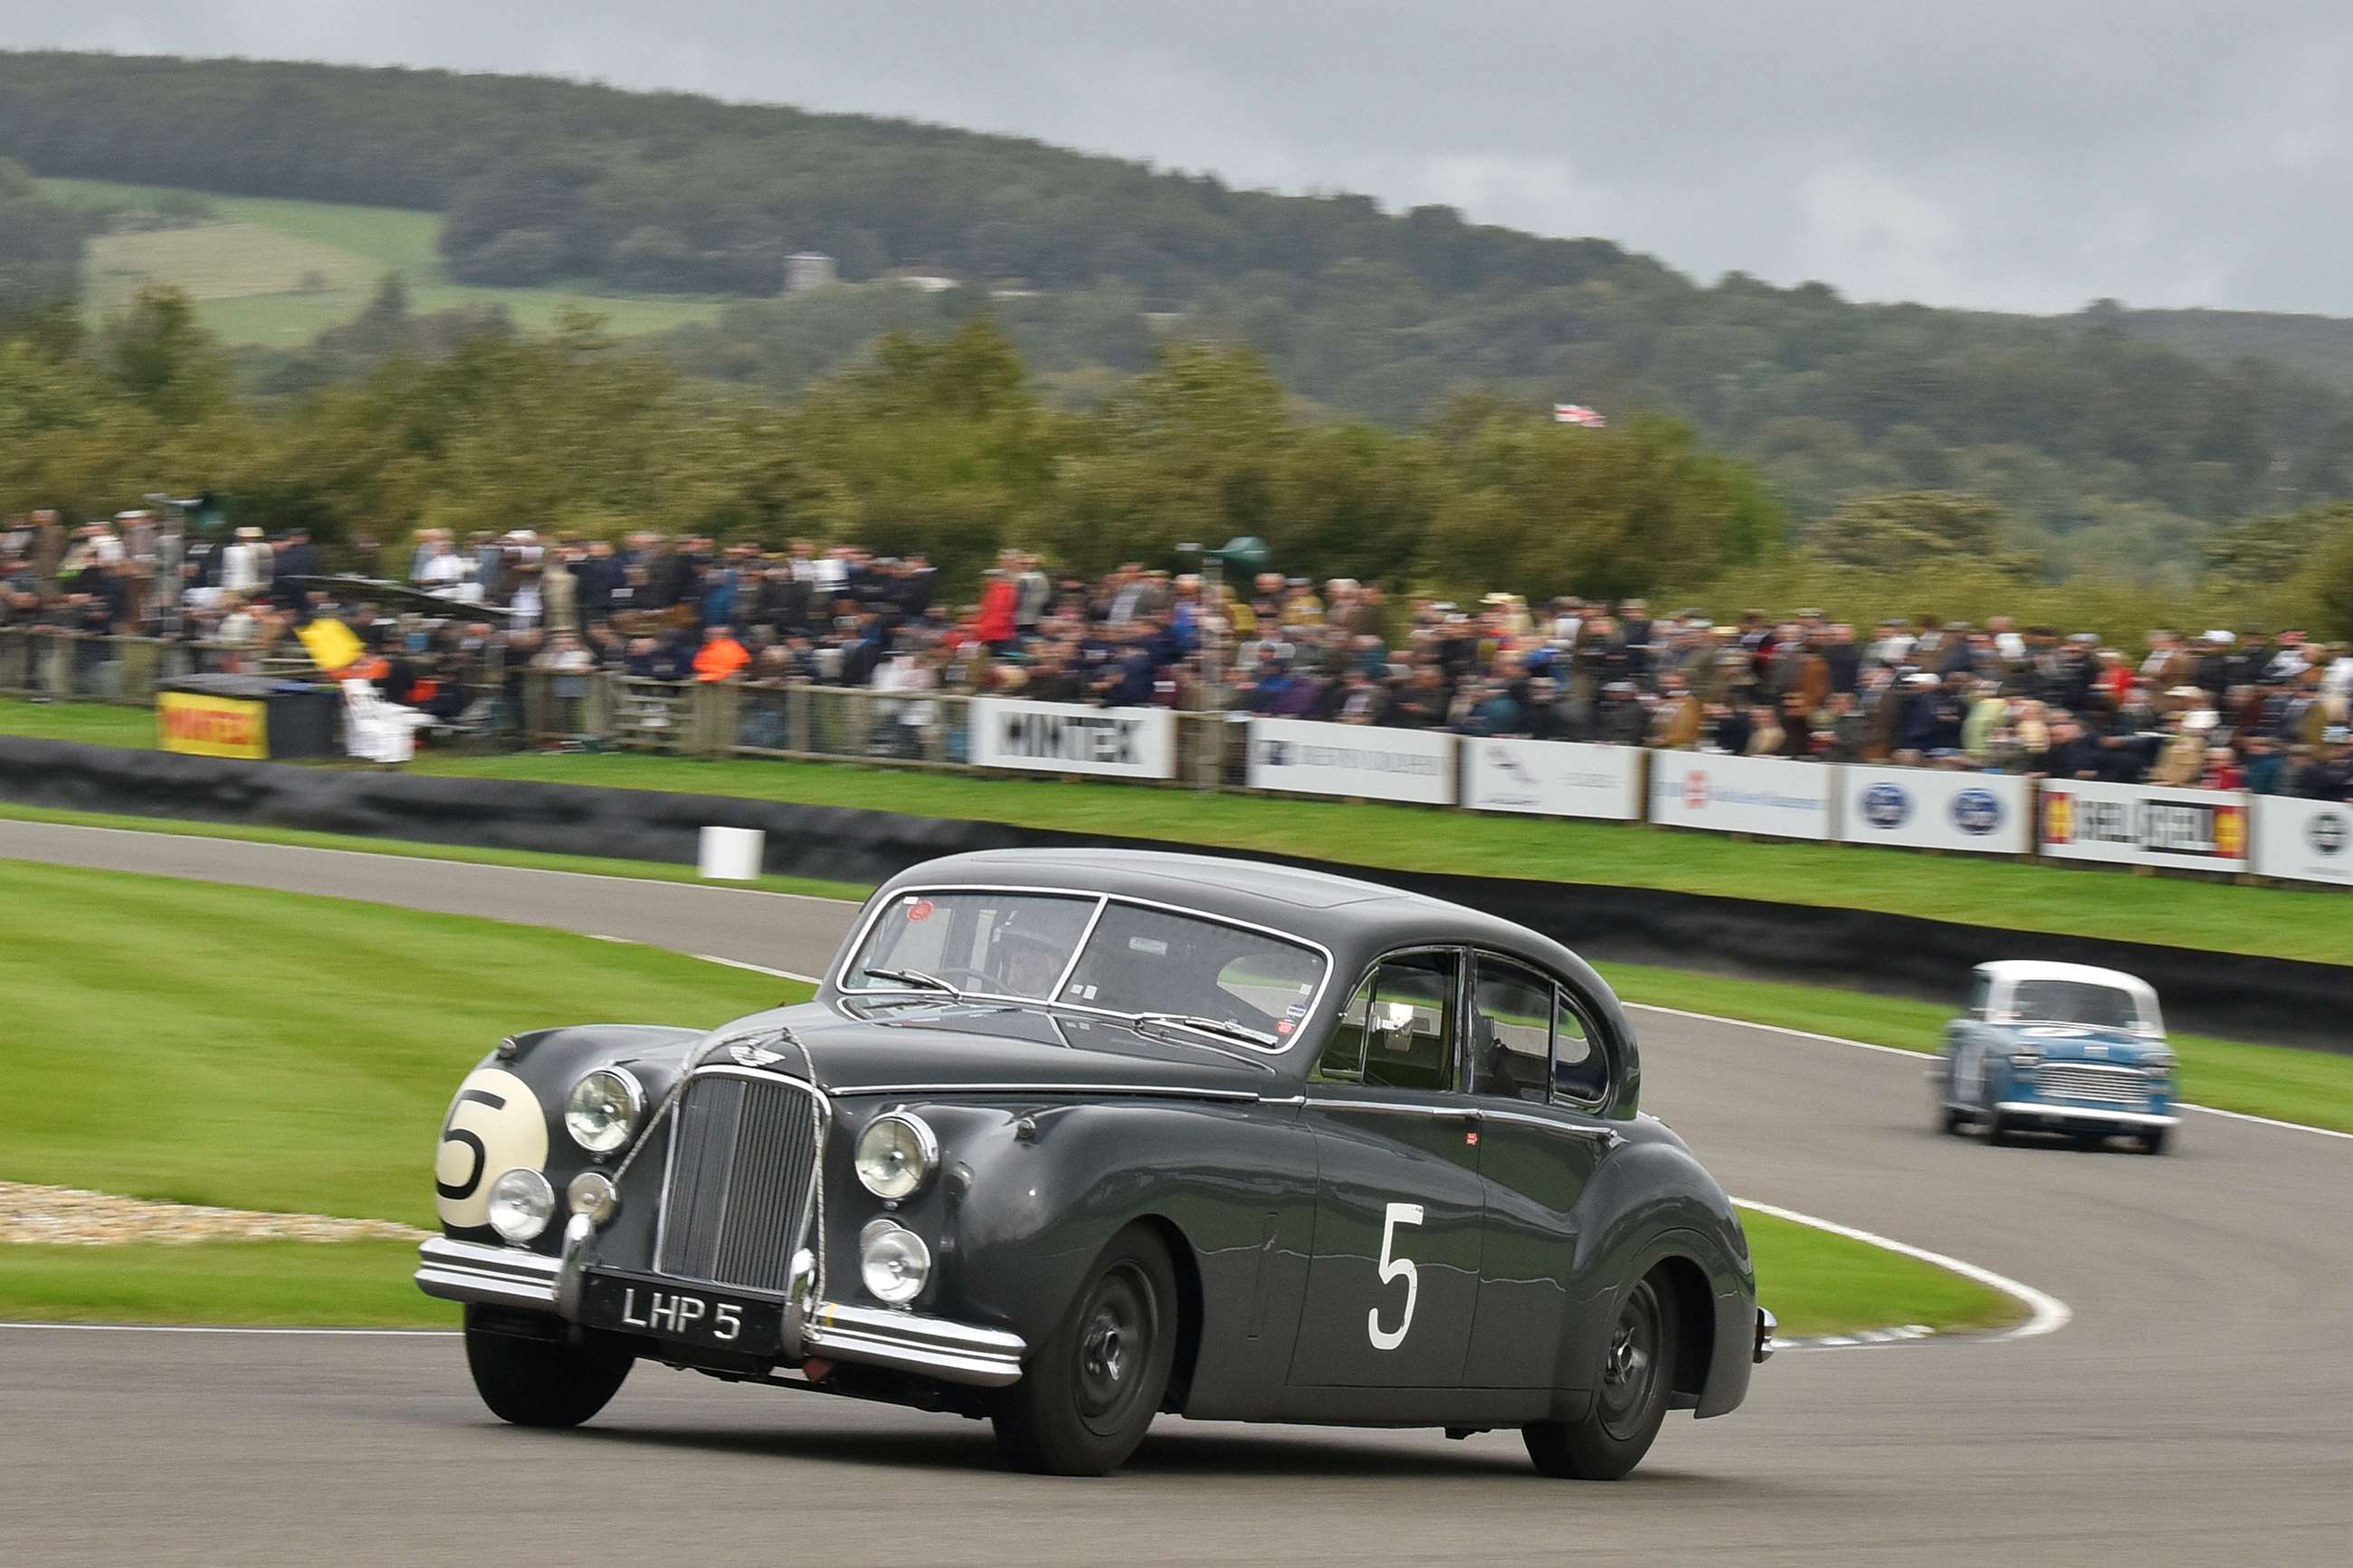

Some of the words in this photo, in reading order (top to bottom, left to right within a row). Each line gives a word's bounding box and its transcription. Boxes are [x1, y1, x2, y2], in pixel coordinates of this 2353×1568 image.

[997, 712, 1144, 765] MINTEX
[436, 1088, 507, 1200] 5
[622, 1288, 706, 1334] LHP
[713, 1305, 742, 1341] 5
[1367, 1202, 1424, 1351] 5
